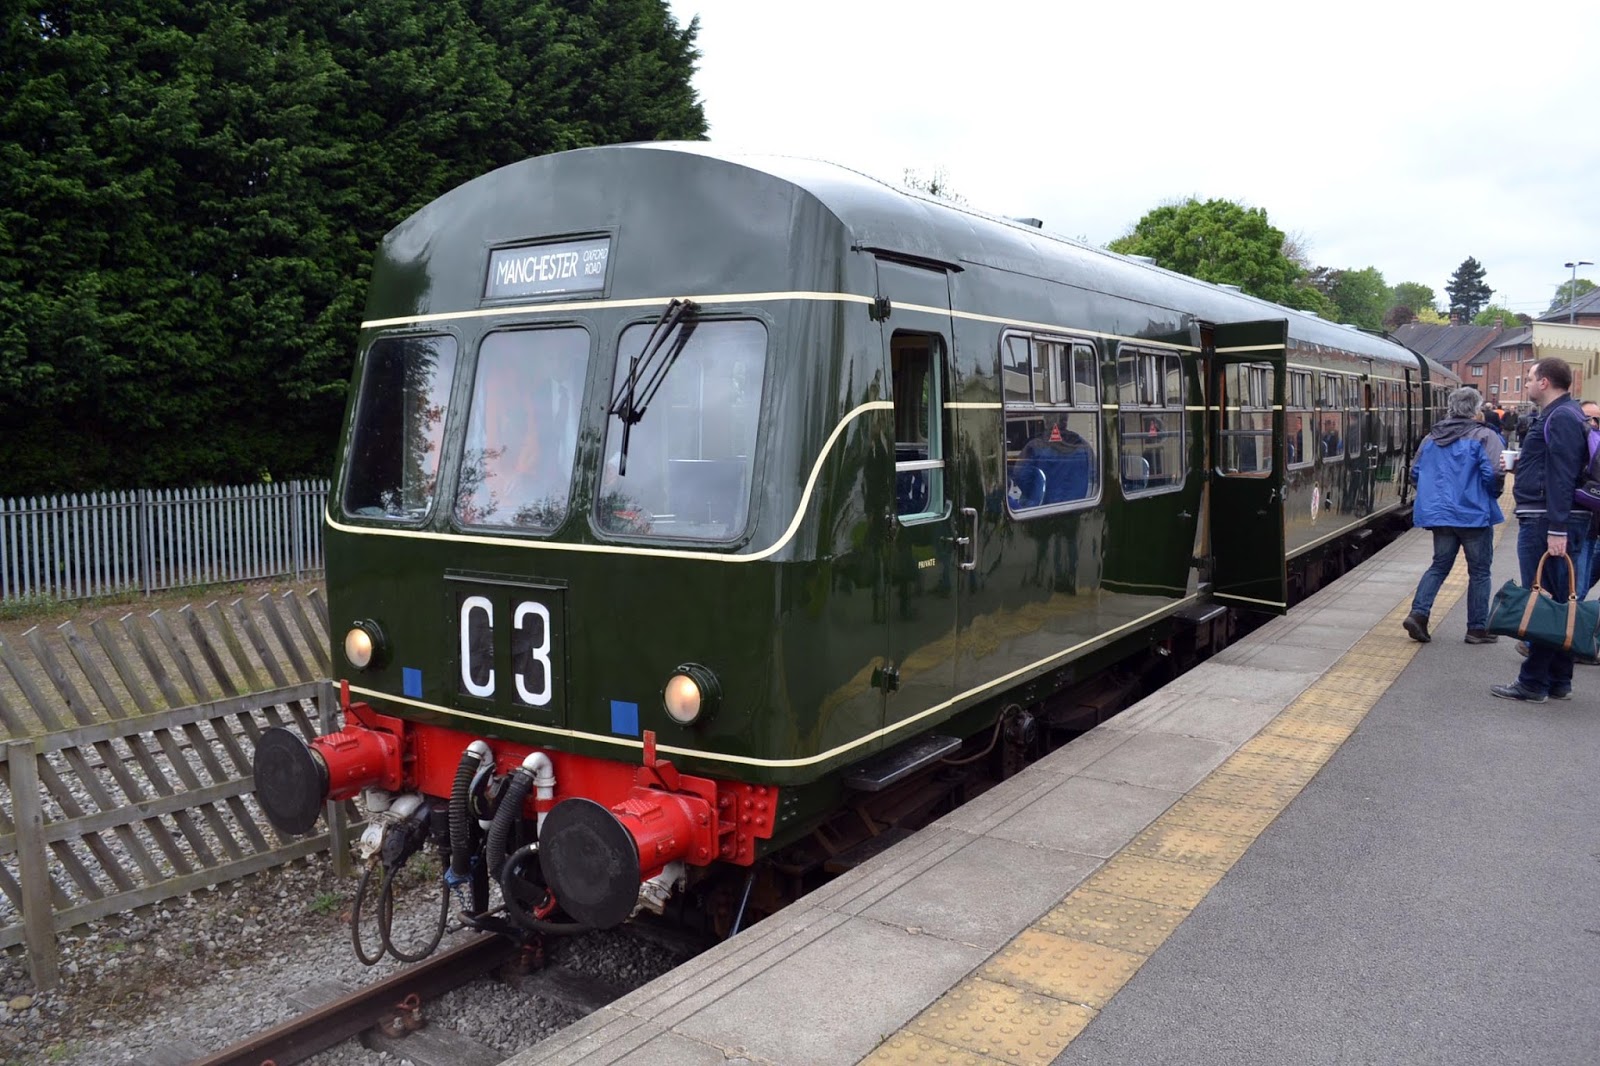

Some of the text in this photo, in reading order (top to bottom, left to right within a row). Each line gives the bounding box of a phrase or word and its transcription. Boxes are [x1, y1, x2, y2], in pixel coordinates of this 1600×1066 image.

[583, 248, 608, 262] OXFORD
[495, 252, 579, 286] MANCHESTER
[584, 262, 602, 275] ROAD
[918, 558, 936, 569] PRIVATE
